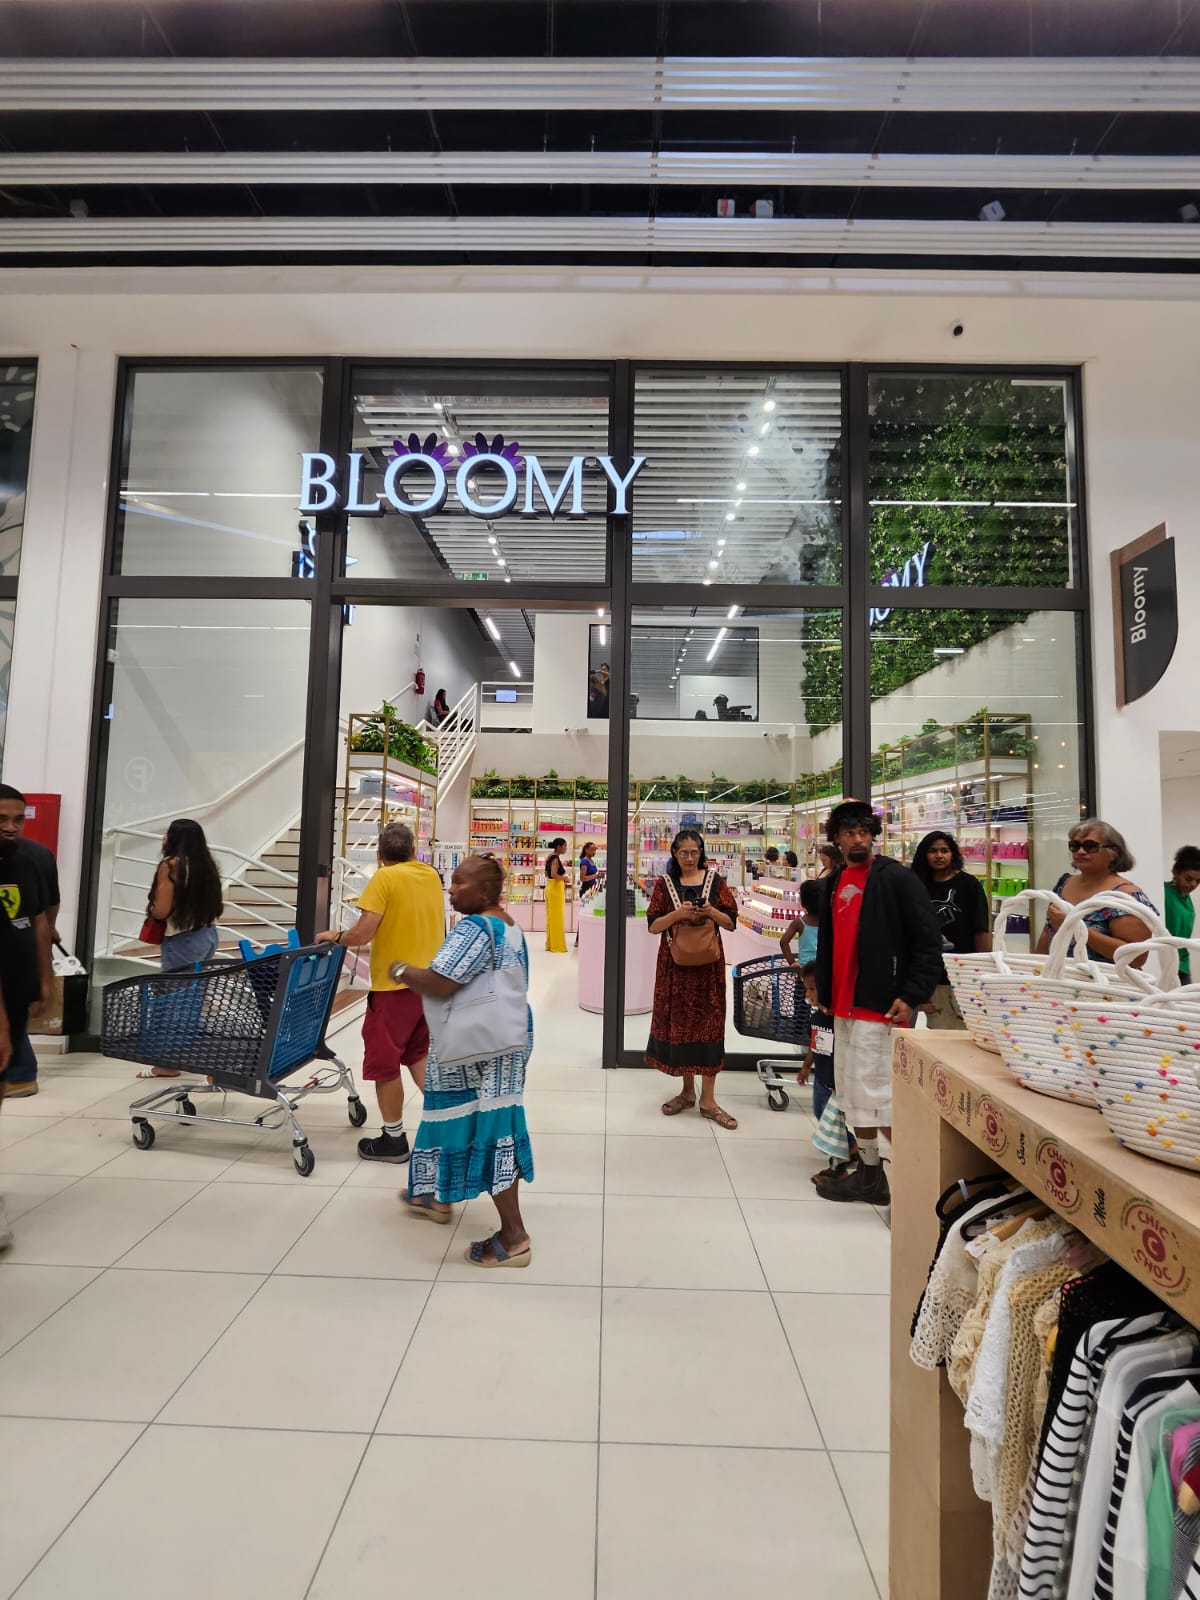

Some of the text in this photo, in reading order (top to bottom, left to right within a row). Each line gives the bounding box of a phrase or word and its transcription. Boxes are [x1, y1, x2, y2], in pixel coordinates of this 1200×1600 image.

[298, 452, 647, 522] BLOOMY
[1129, 566, 1149, 644] Bloomy
[983, 1102, 999, 1119] CHIC
[1047, 1147, 1069, 1169] CHIC
[1045, 1179, 1071, 1203] CHOC
[1137, 1210, 1168, 1241] CHIC
[1136, 1248, 1172, 1282] CHOC
